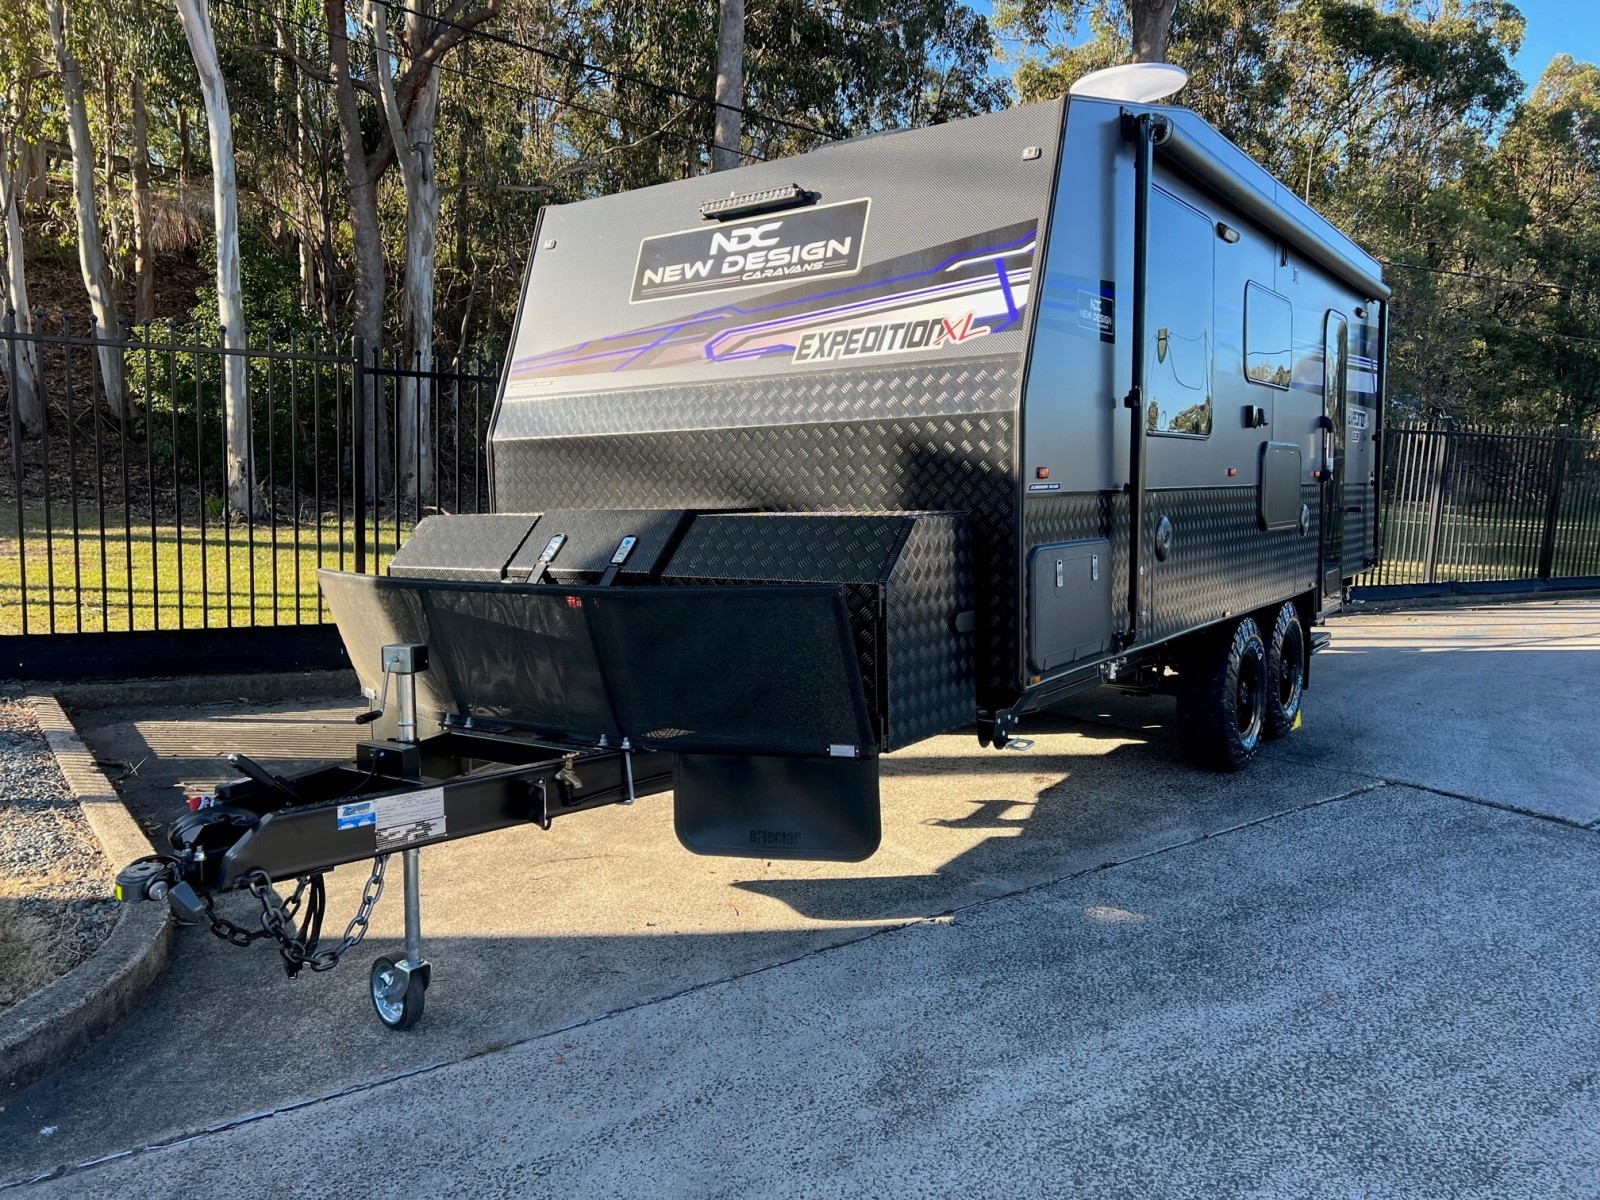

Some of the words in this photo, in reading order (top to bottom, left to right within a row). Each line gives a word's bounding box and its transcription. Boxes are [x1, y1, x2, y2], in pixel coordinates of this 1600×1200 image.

[709, 221, 783, 255] NDC
[642, 259, 714, 286] NEW
[721, 236, 852, 274] DESIGN
[741, 261, 824, 281] CARAVANS
